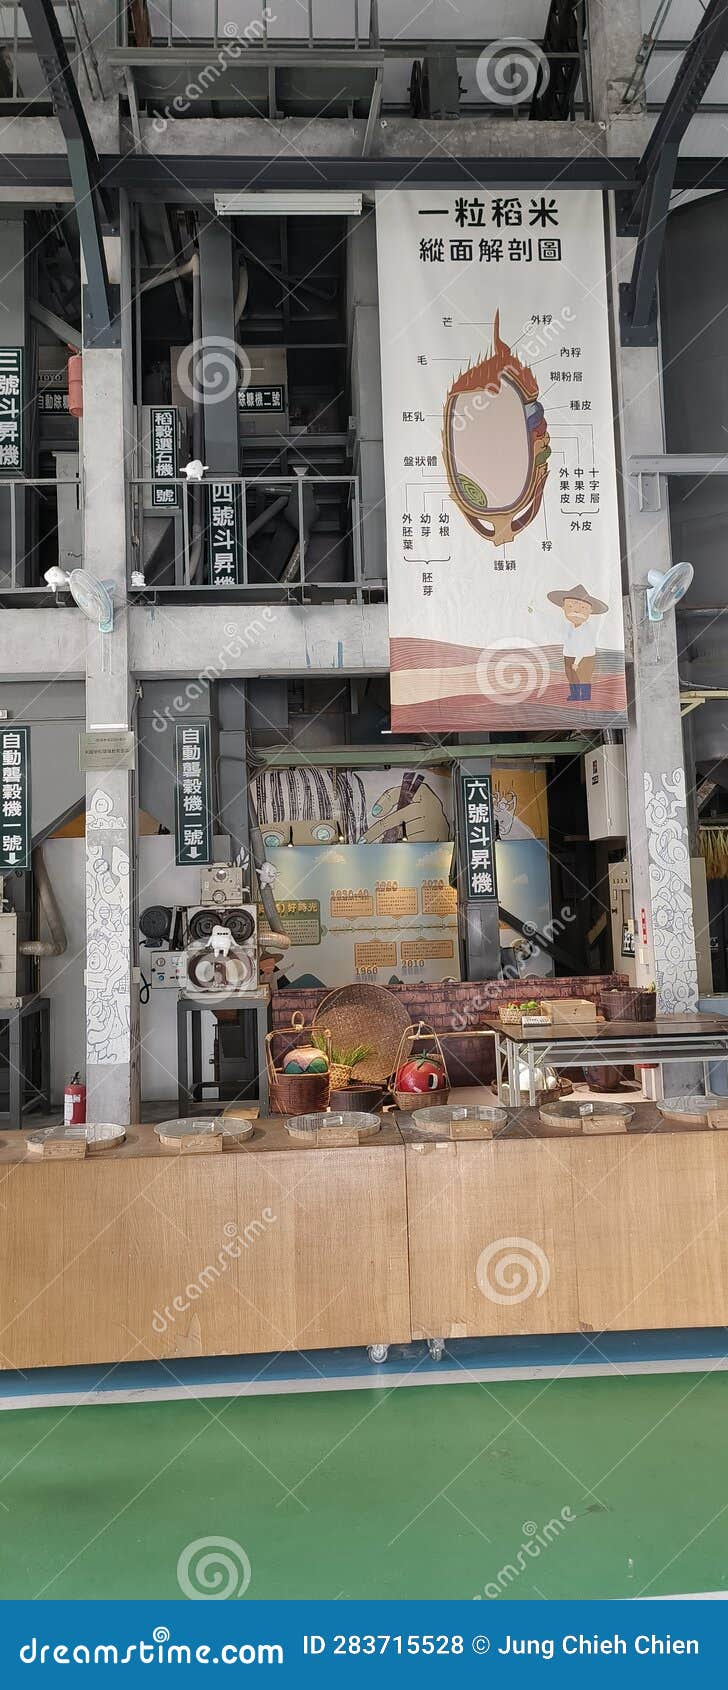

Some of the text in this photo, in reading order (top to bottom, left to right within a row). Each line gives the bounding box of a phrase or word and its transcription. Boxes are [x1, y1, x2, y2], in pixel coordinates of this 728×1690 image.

[418, 197, 560, 228] 一粒稻米
[418, 238, 563, 263] 縱面解剖圖
[441, 317, 454, 328] 芒
[416, 355, 428, 366] 毛
[549, 371, 583, 383] 糊粉層
[0, 352, 20, 466] 三號斗昇機
[402, 411, 426, 422] 胚乳
[569, 400, 593, 411] 種皮
[403, 455, 439, 467] 盤狀體
[559, 467, 571, 504] 外果皮
[573, 467, 586, 504] 中果皮
[588, 467, 600, 504] 十字層
[402, 513, 414, 550] 外胚葉
[420, 513, 432, 537] 幼芽
[438, 513, 450, 537] 幼根
[570, 520, 593, 532] 外皮
[421, 572, 434, 597] 胚芽
[467, 780, 493, 893] 六號斗昇機
